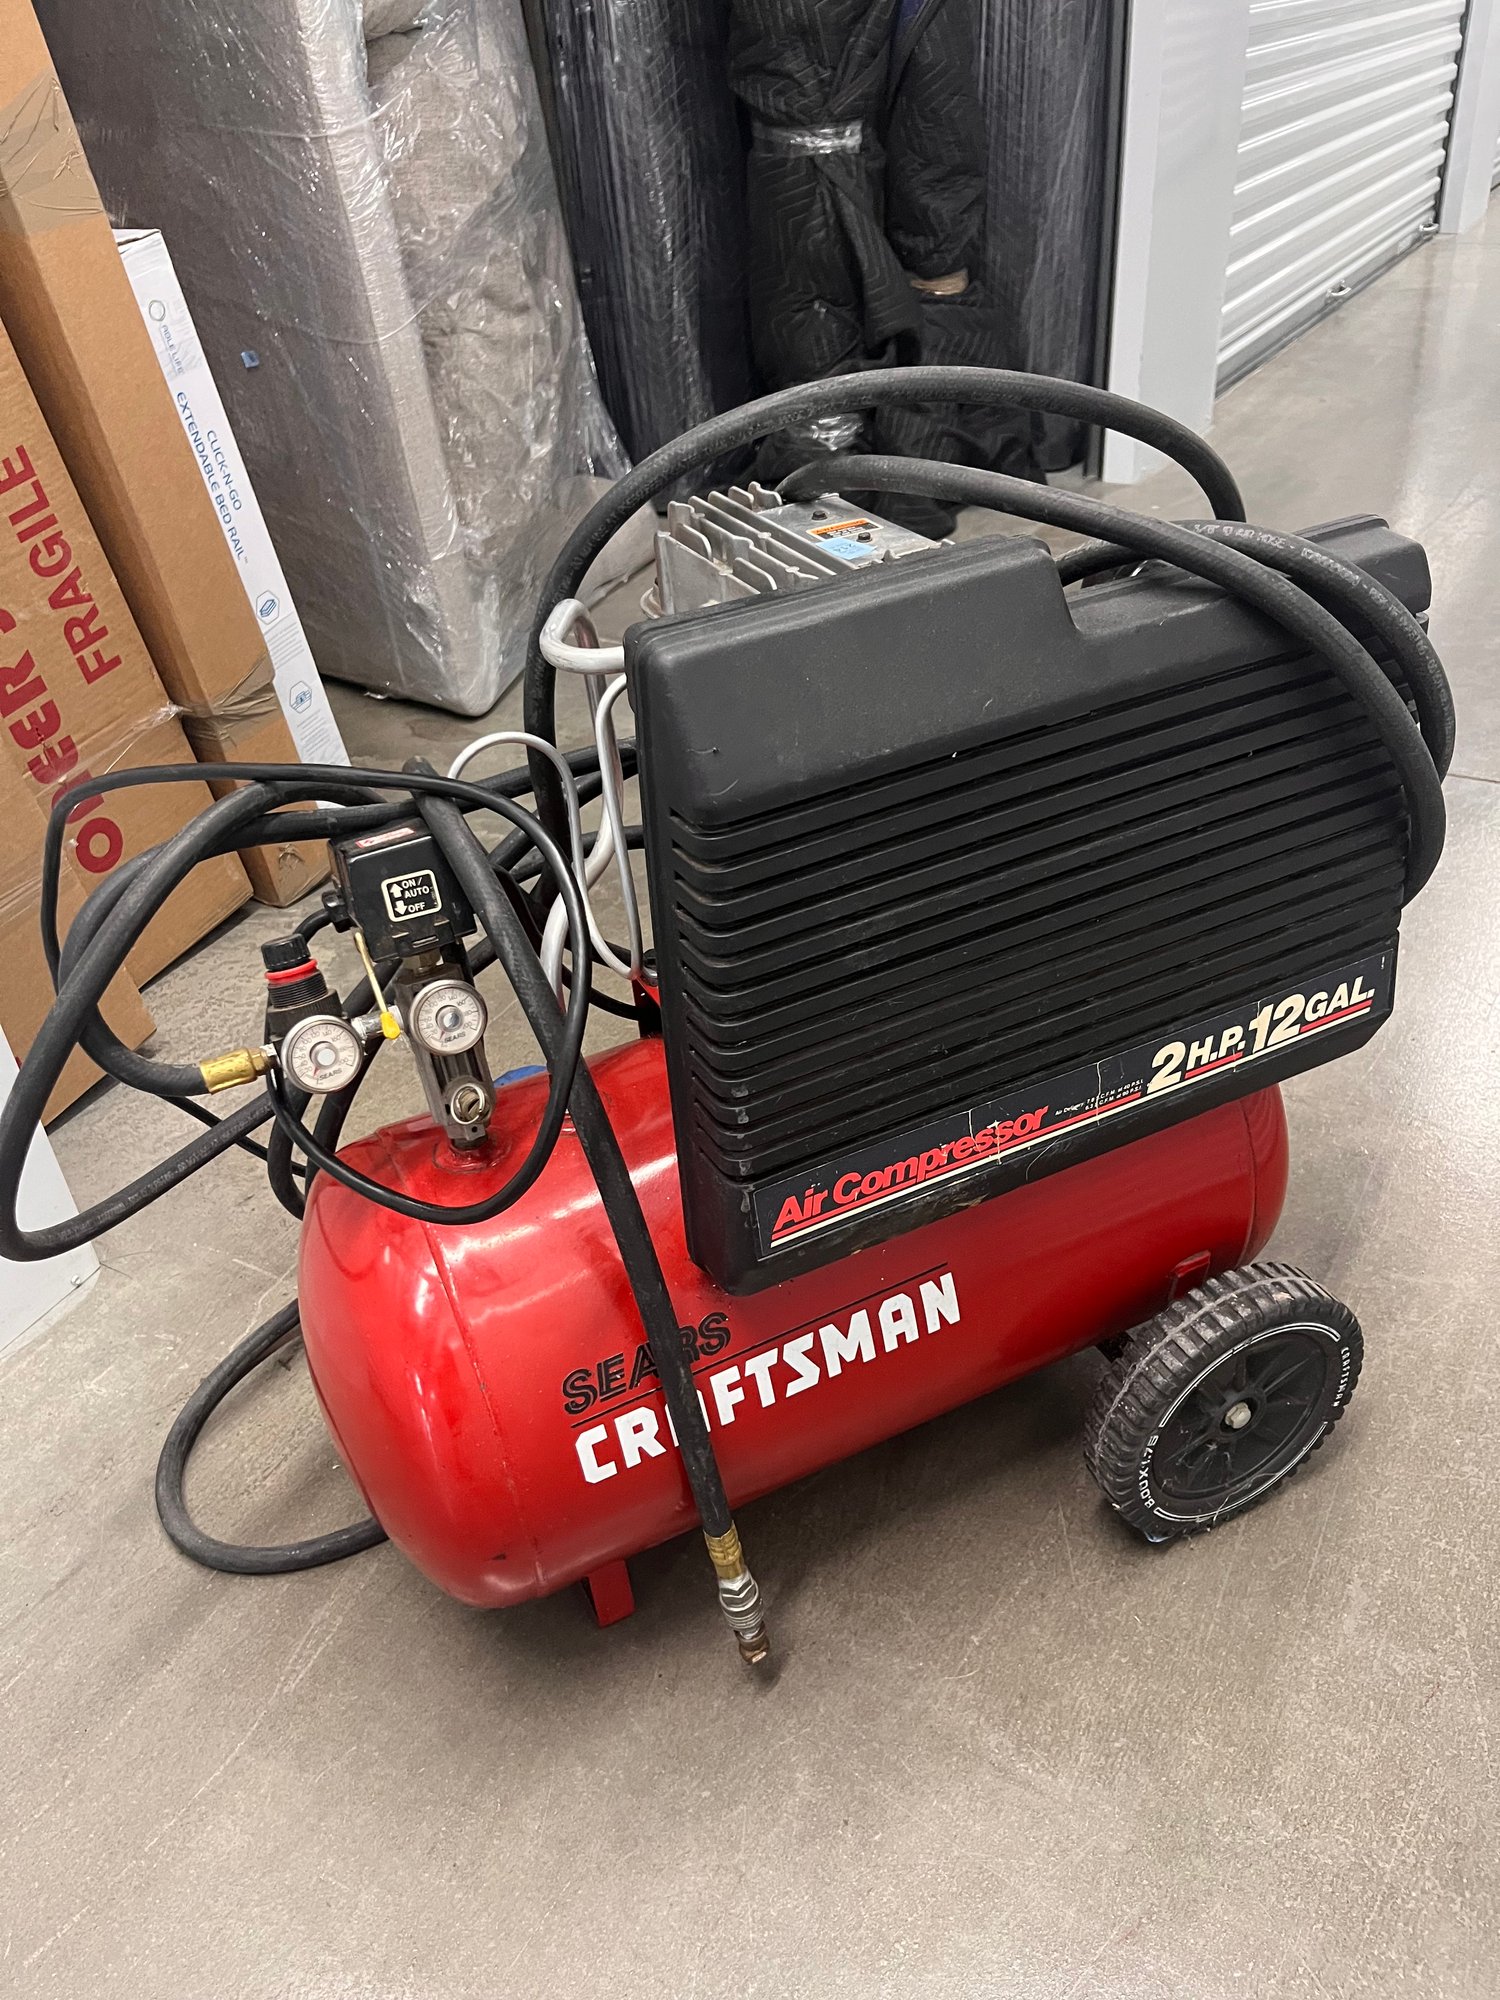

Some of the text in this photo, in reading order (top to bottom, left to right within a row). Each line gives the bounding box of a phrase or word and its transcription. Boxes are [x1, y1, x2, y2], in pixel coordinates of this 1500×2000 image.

[176, 391, 220, 493] EXTENDABLE
[214, 488, 232, 525] BED
[206, 430, 242, 511] CLICK-N-GO
[0, 444, 123, 684] FRAGILE
[404, 886, 430, 899] AUTO
[407, 902, 426, 913] OFF
[319, 1069, 343, 1081] SEARS
[1146, 975, 1376, 1095] 2 H.P. 12 GAL.
[772, 1105, 1049, 1232] Air Compressor
